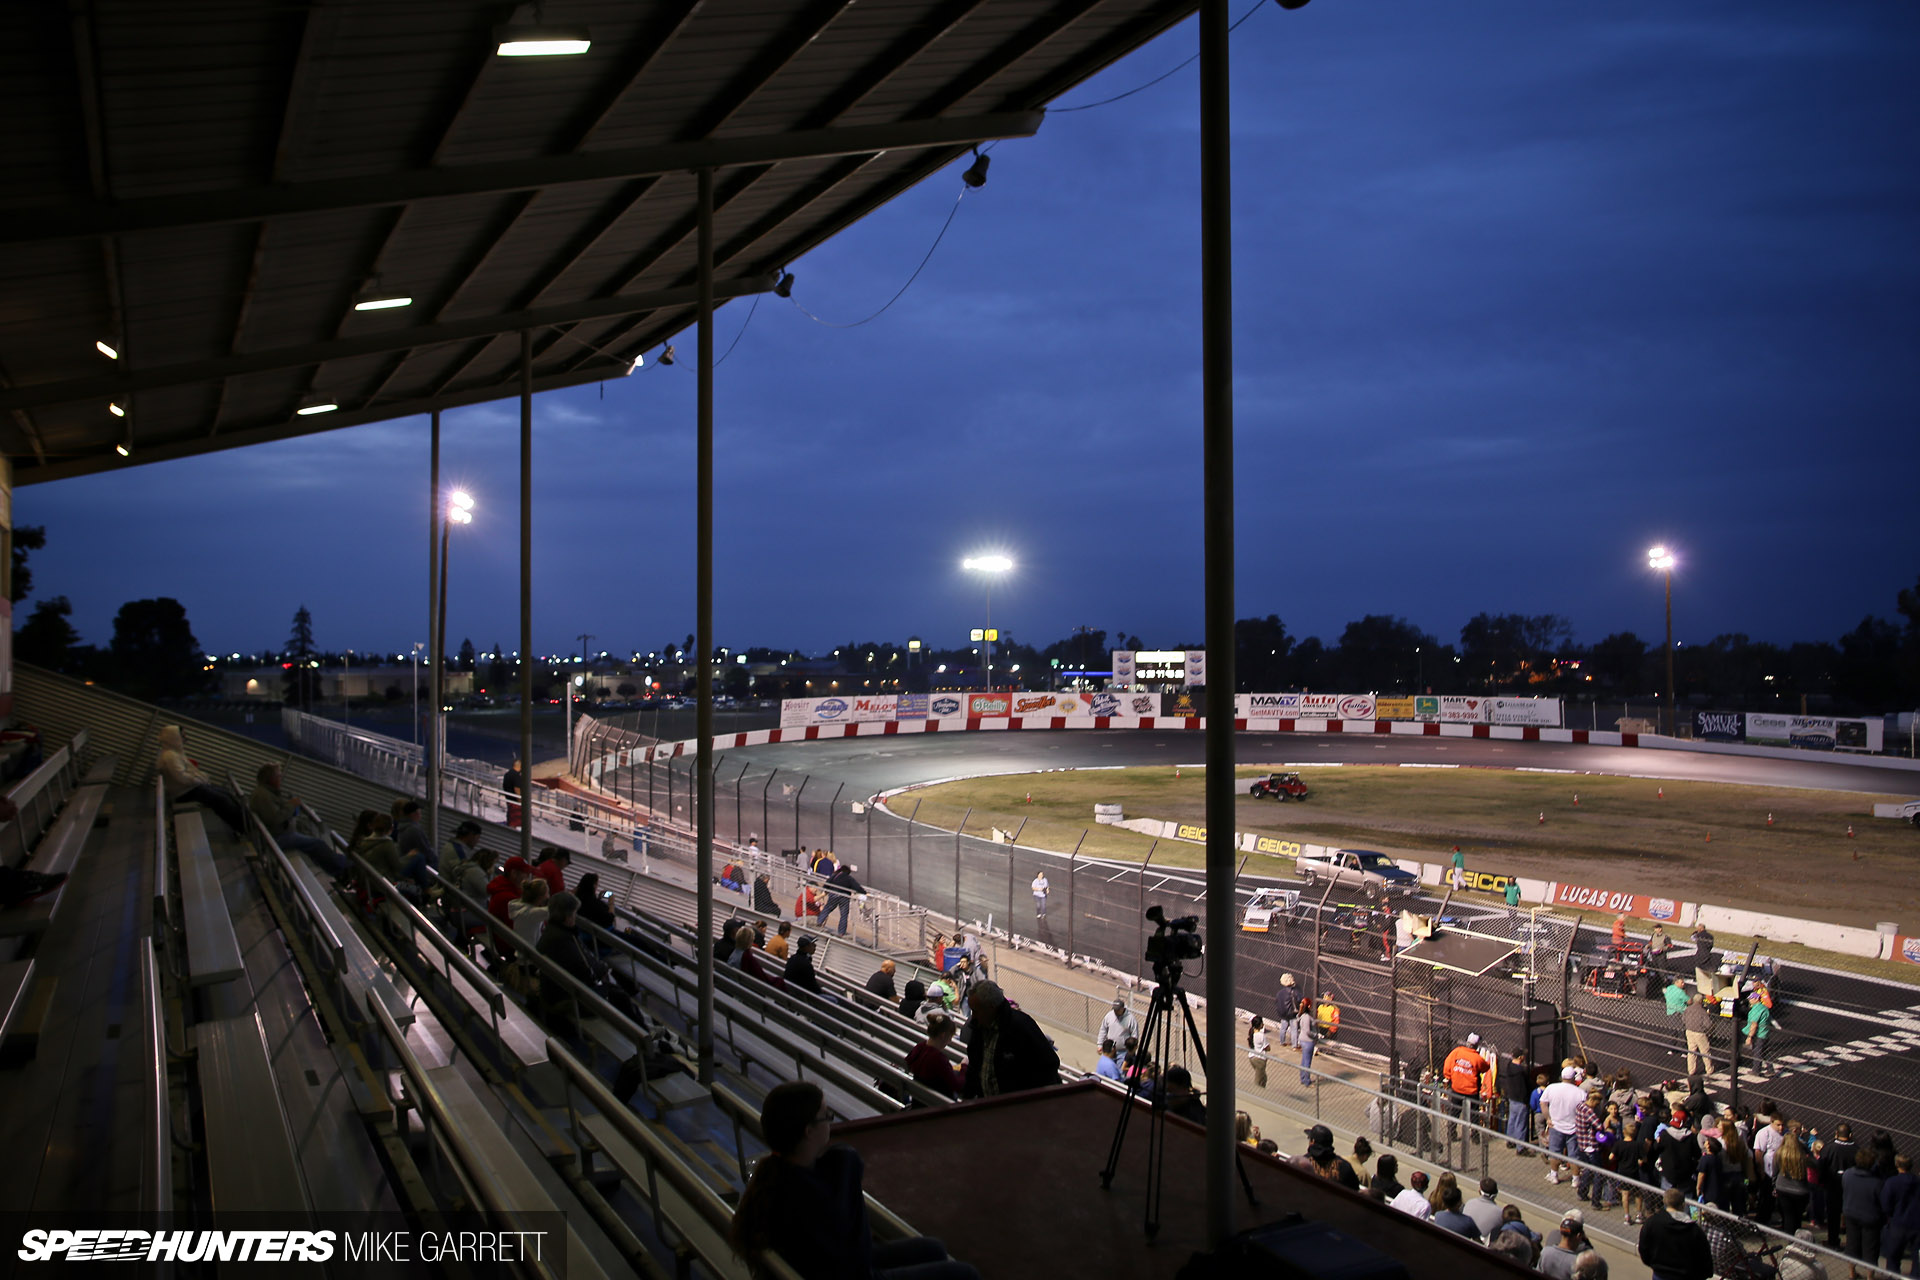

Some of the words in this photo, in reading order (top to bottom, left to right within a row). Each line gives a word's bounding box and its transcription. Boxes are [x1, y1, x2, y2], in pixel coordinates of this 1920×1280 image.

[973, 699, 1008, 713] O'Reilly
[1250, 696, 1299, 705] MAVTV
[1250, 709, 1299, 717] GetMAVTV.com
[1698, 712, 1742, 727] SAMUEL
[1701, 721, 1738, 736] ADAMS
[1178, 825, 1207, 841] GEIC
[1257, 837, 1300, 857] GEICO
[1560, 885, 1608, 908] LUCAS
[1609, 893, 1635, 912] OIL
